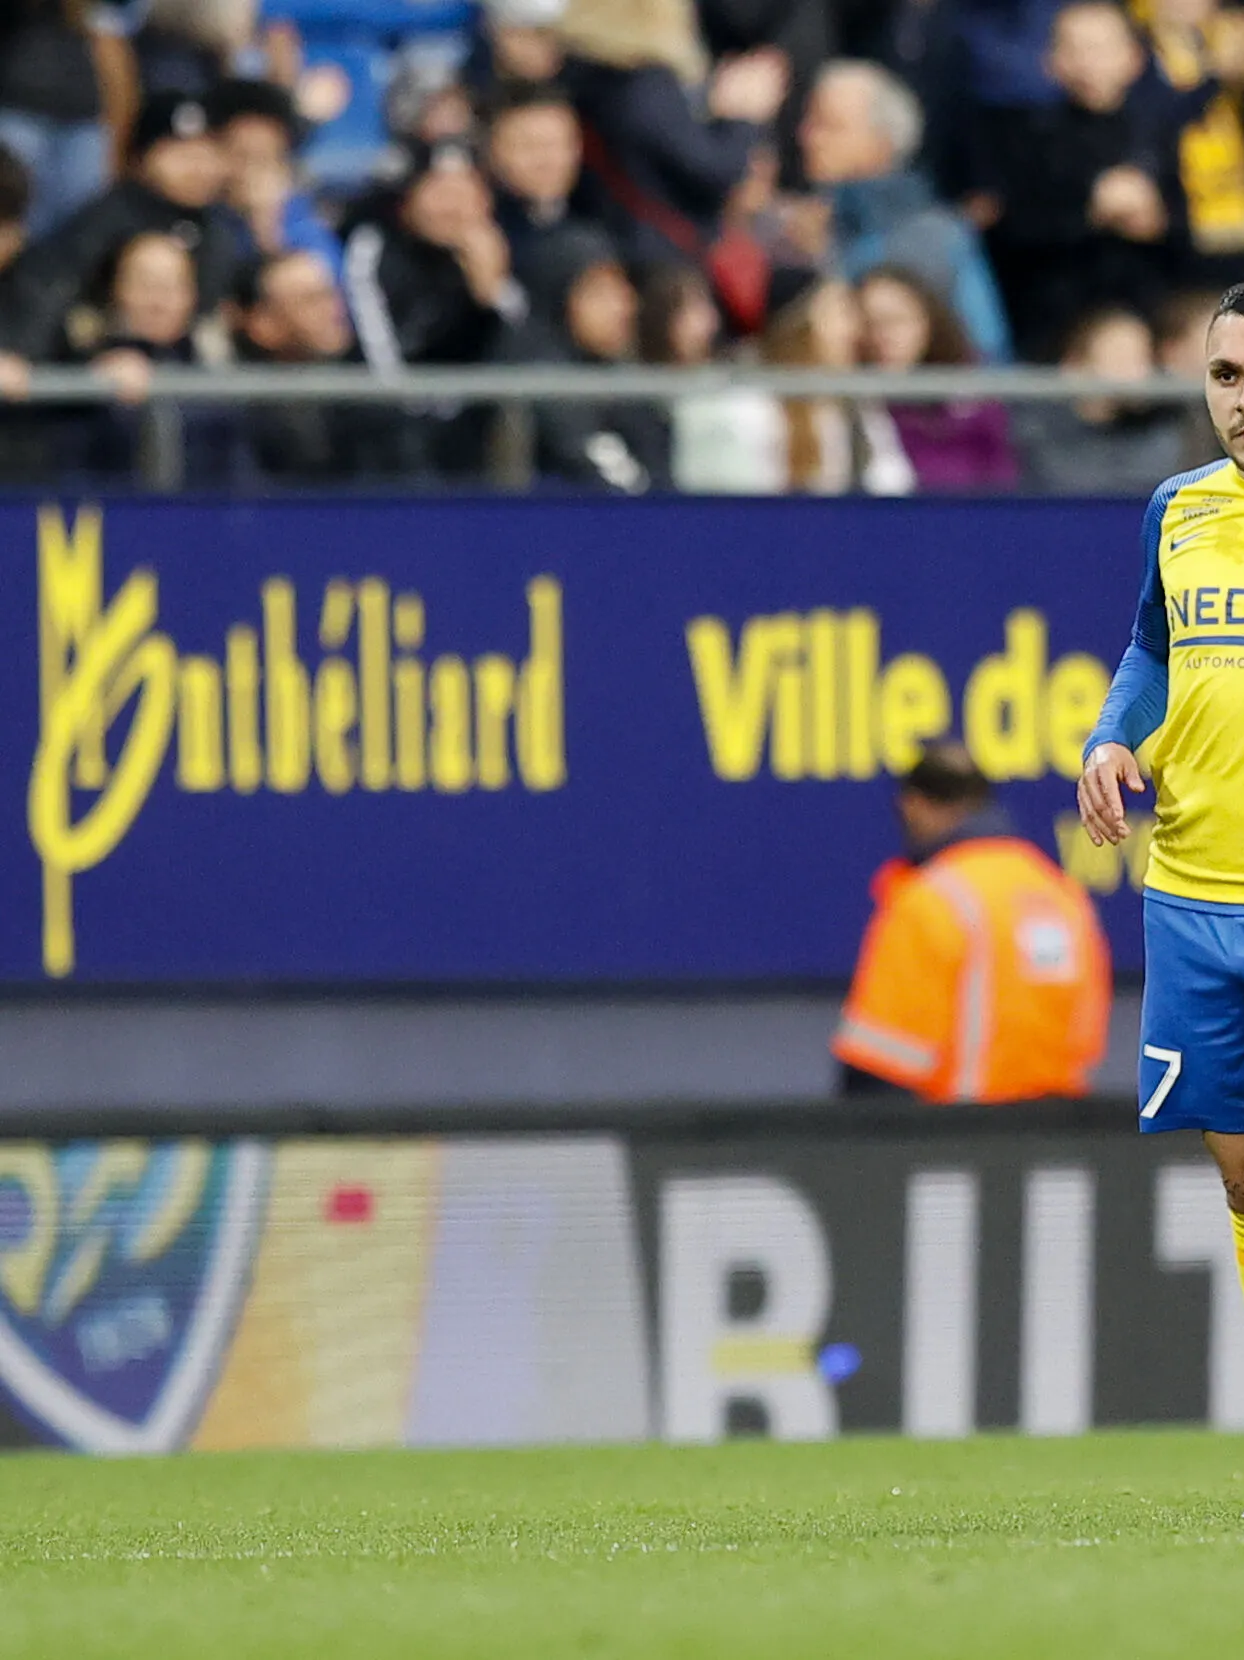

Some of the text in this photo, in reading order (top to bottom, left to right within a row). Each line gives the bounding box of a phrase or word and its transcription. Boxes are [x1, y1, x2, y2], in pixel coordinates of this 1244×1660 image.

[685, 604, 951, 782] Ville
[963, 605, 1114, 782] de
[1139, 1044, 1182, 1118] 7
